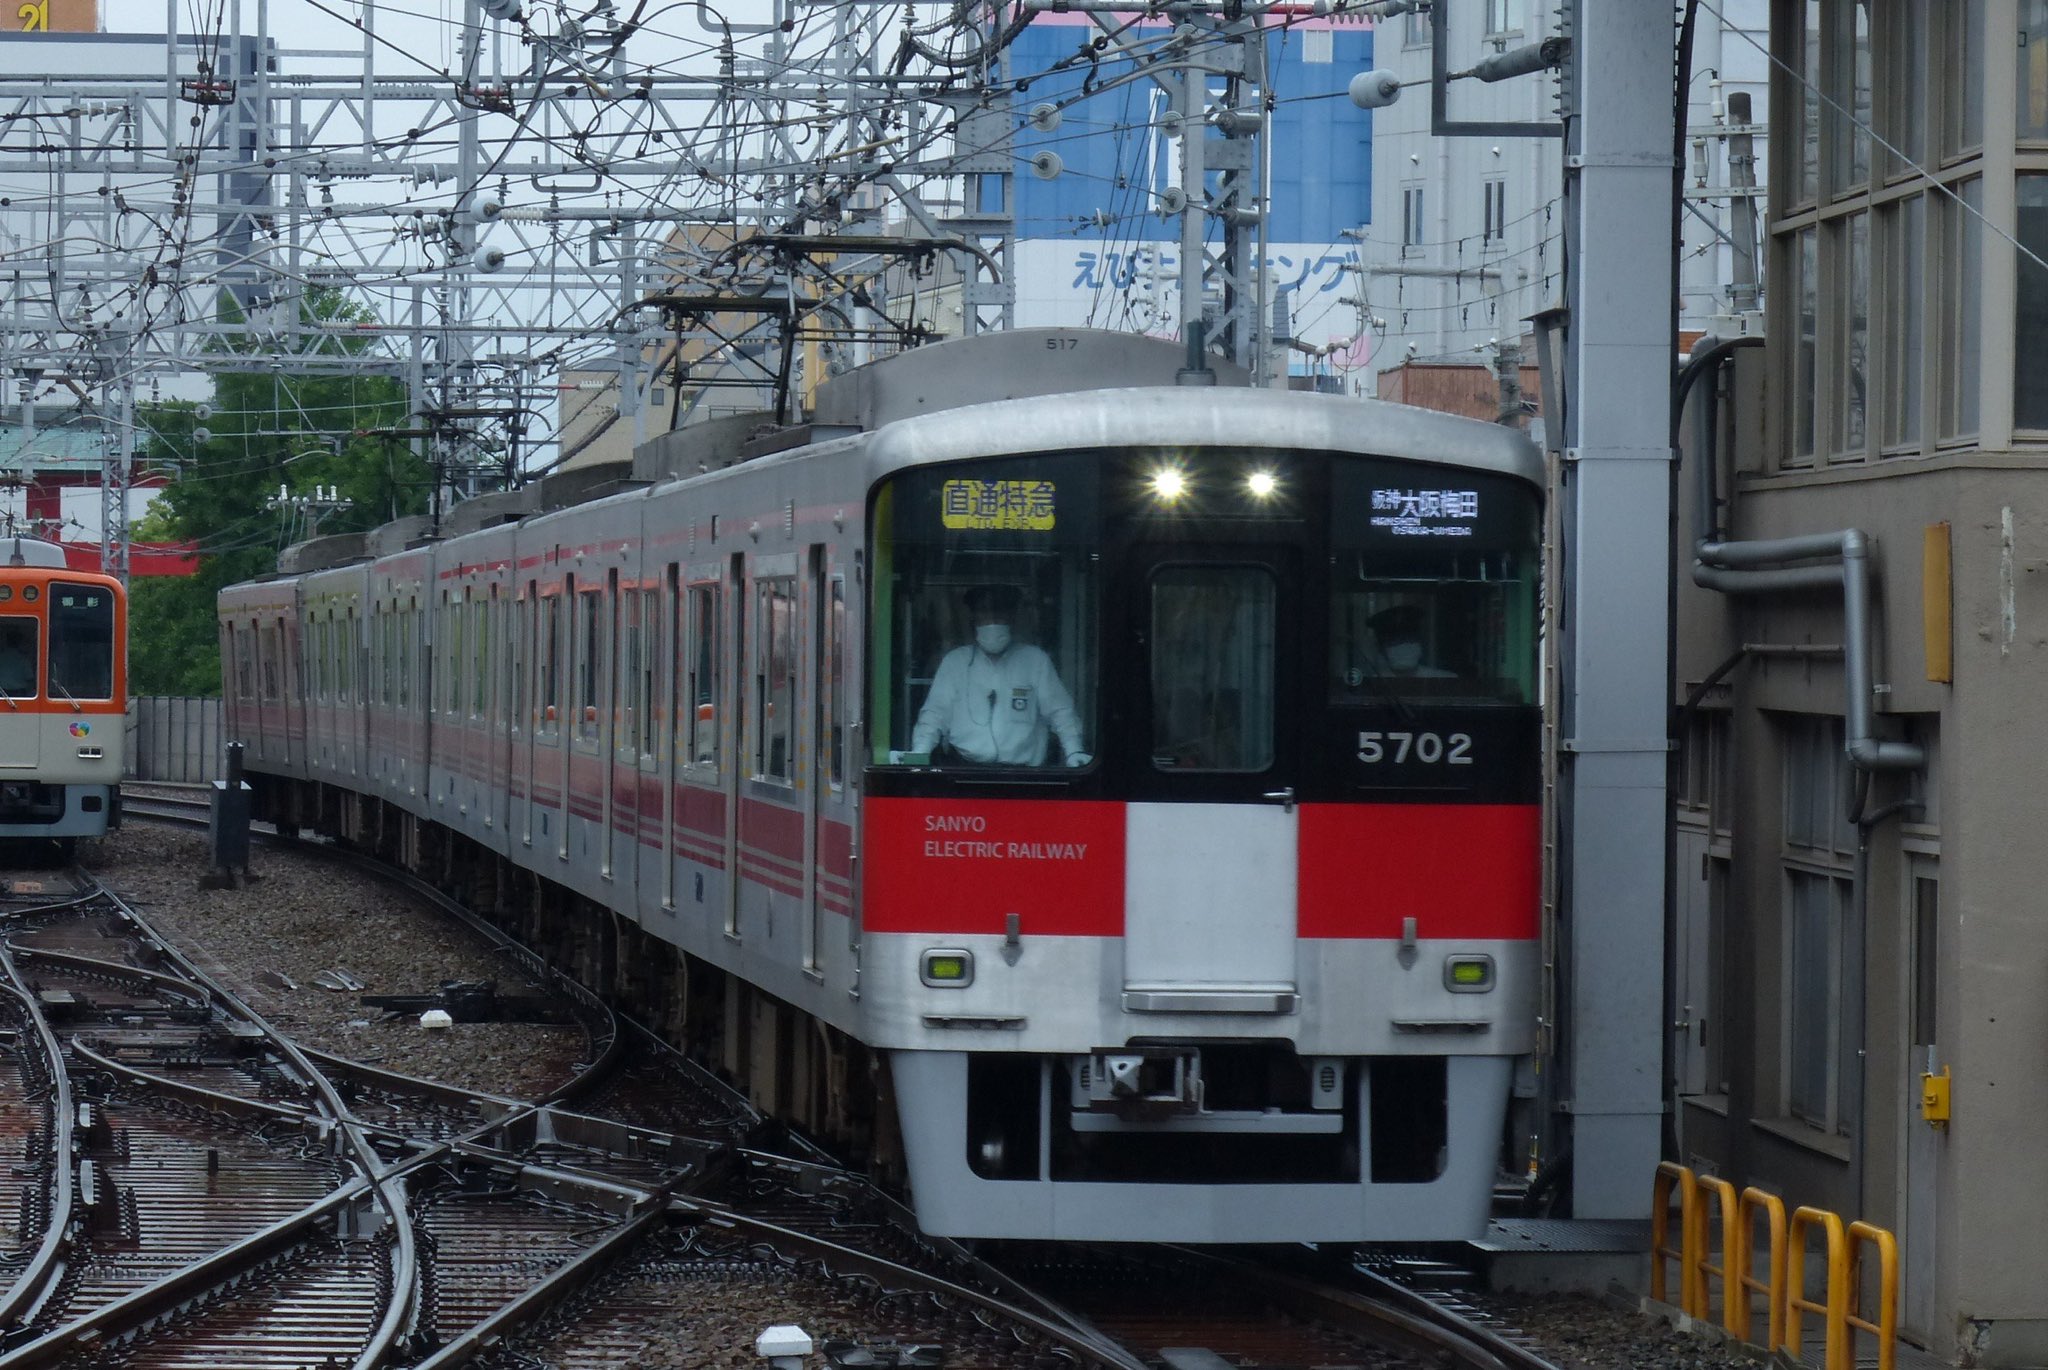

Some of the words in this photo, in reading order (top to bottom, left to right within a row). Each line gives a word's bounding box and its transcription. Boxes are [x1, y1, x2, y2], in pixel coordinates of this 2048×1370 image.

[1047, 338, 1078, 350] 517
[946, 480, 1057, 517] 直通特急
[1357, 731, 1474, 766] 5702
[924, 815, 986, 833] SANYO
[924, 840, 1004, 858] ELECTRIC
[1007, 842, 1088, 860] RAILWAY
